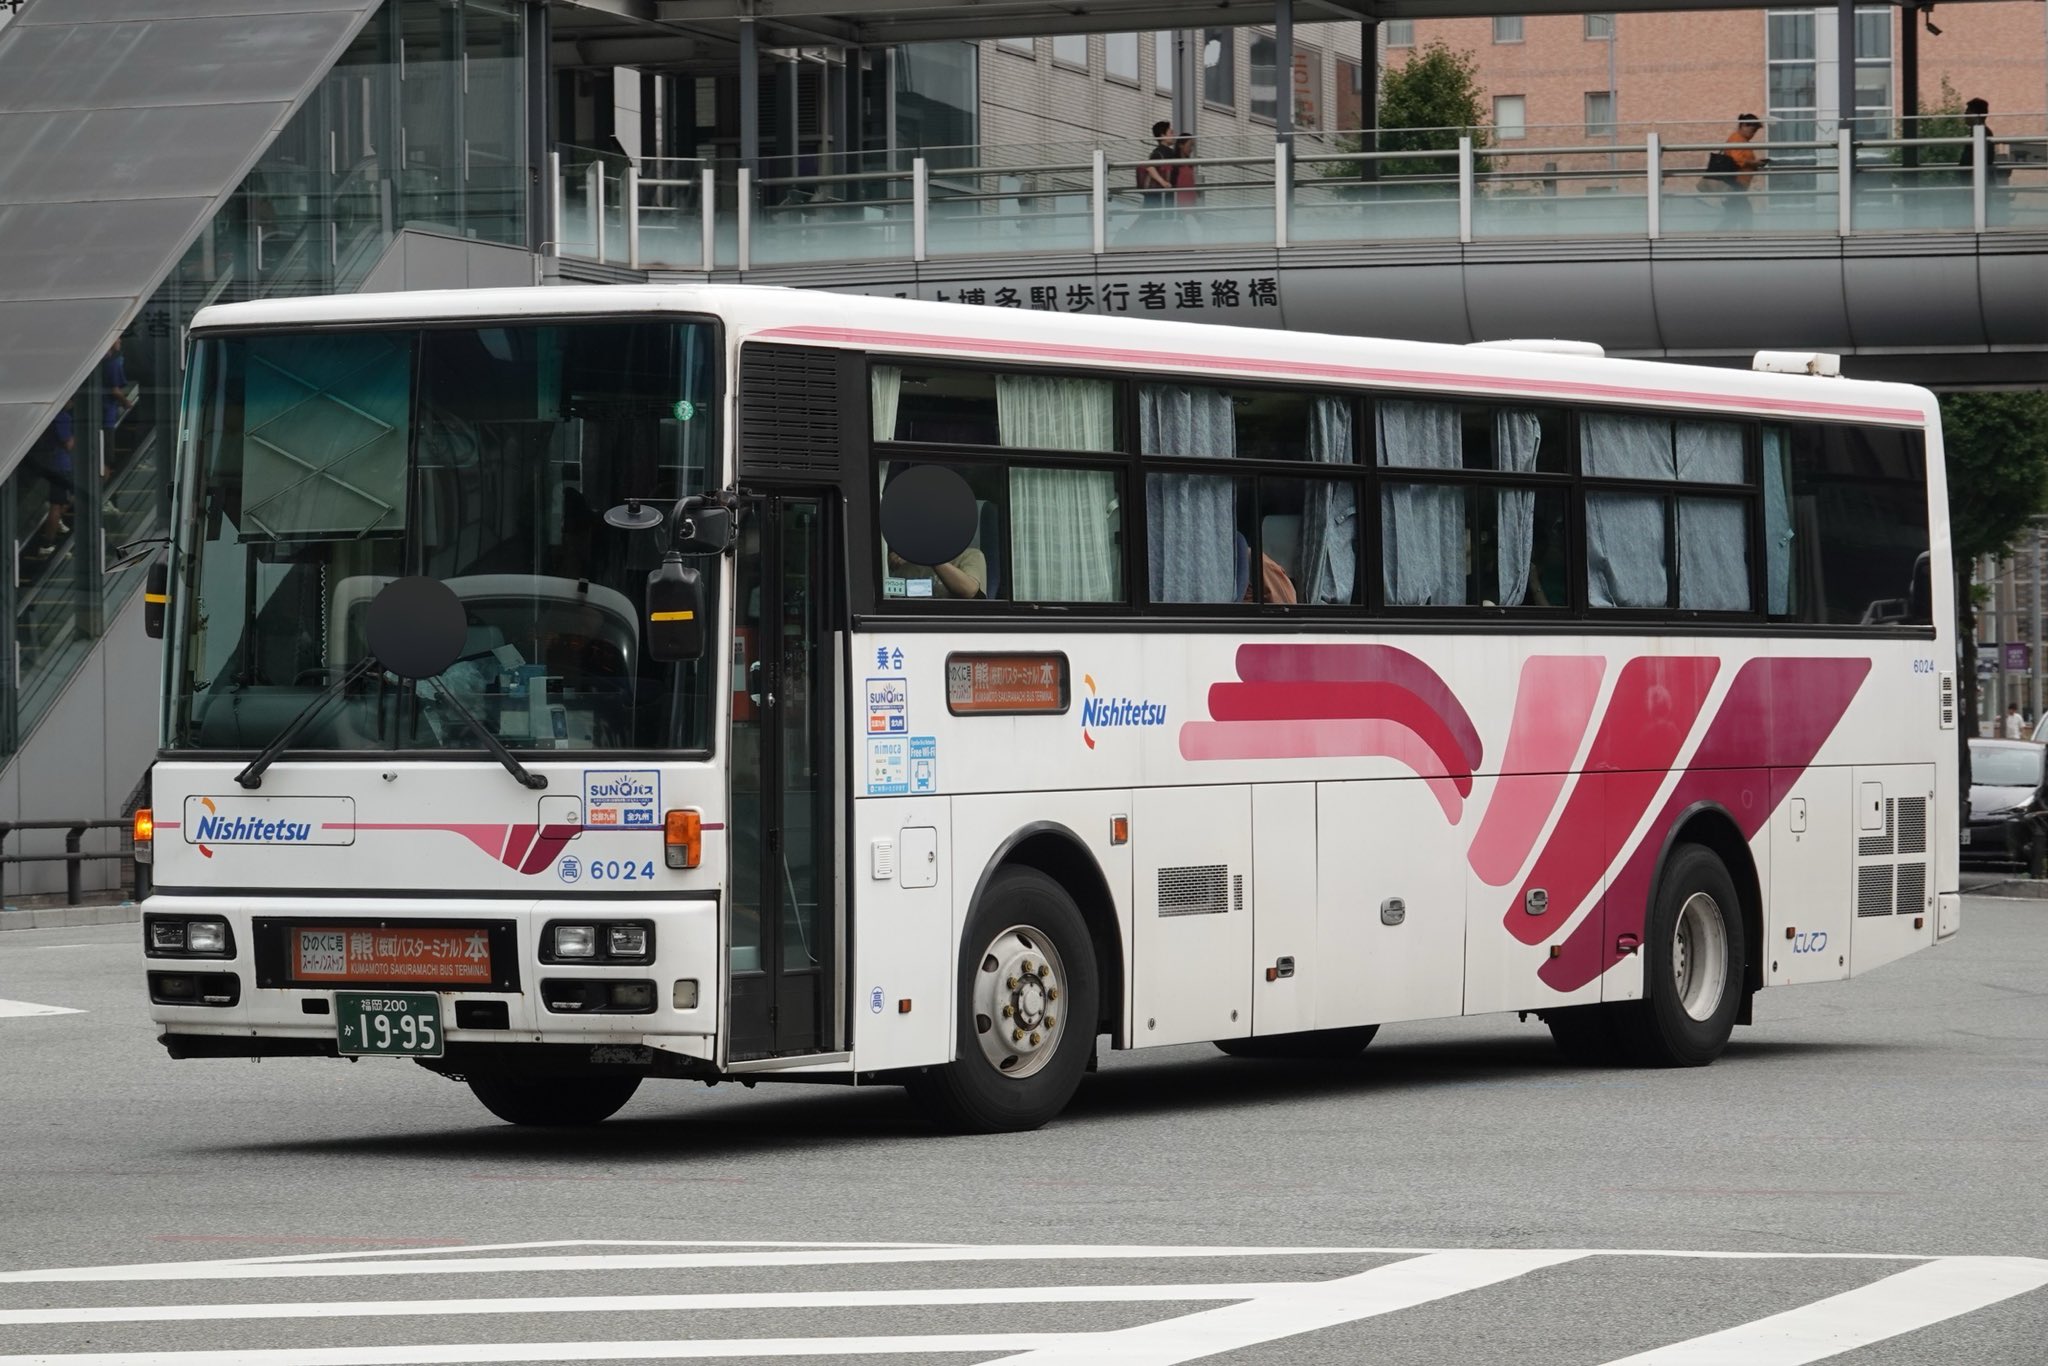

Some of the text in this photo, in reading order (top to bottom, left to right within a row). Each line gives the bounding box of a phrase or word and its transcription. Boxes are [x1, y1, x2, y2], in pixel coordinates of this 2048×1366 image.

[877, 647, 904, 670] 乗合
[1913, 659, 1934, 673] 6024
[1081, 697, 1166, 727] Nishitetsu
[874, 741, 901, 754] nimoca
[590, 783, 653, 796] SUNQパス
[196, 815, 311, 841] Nishitetsu
[562, 858, 655, 880] 高 6024
[302, 935, 344, 952] ひのくに号
[1793, 932, 1828, 953] にしてつ
[351, 963, 488, 977] KUMAMOTO SAKURAMACHI BUS TERMINAL
[344, 1014, 436, 1050] か 19-95
